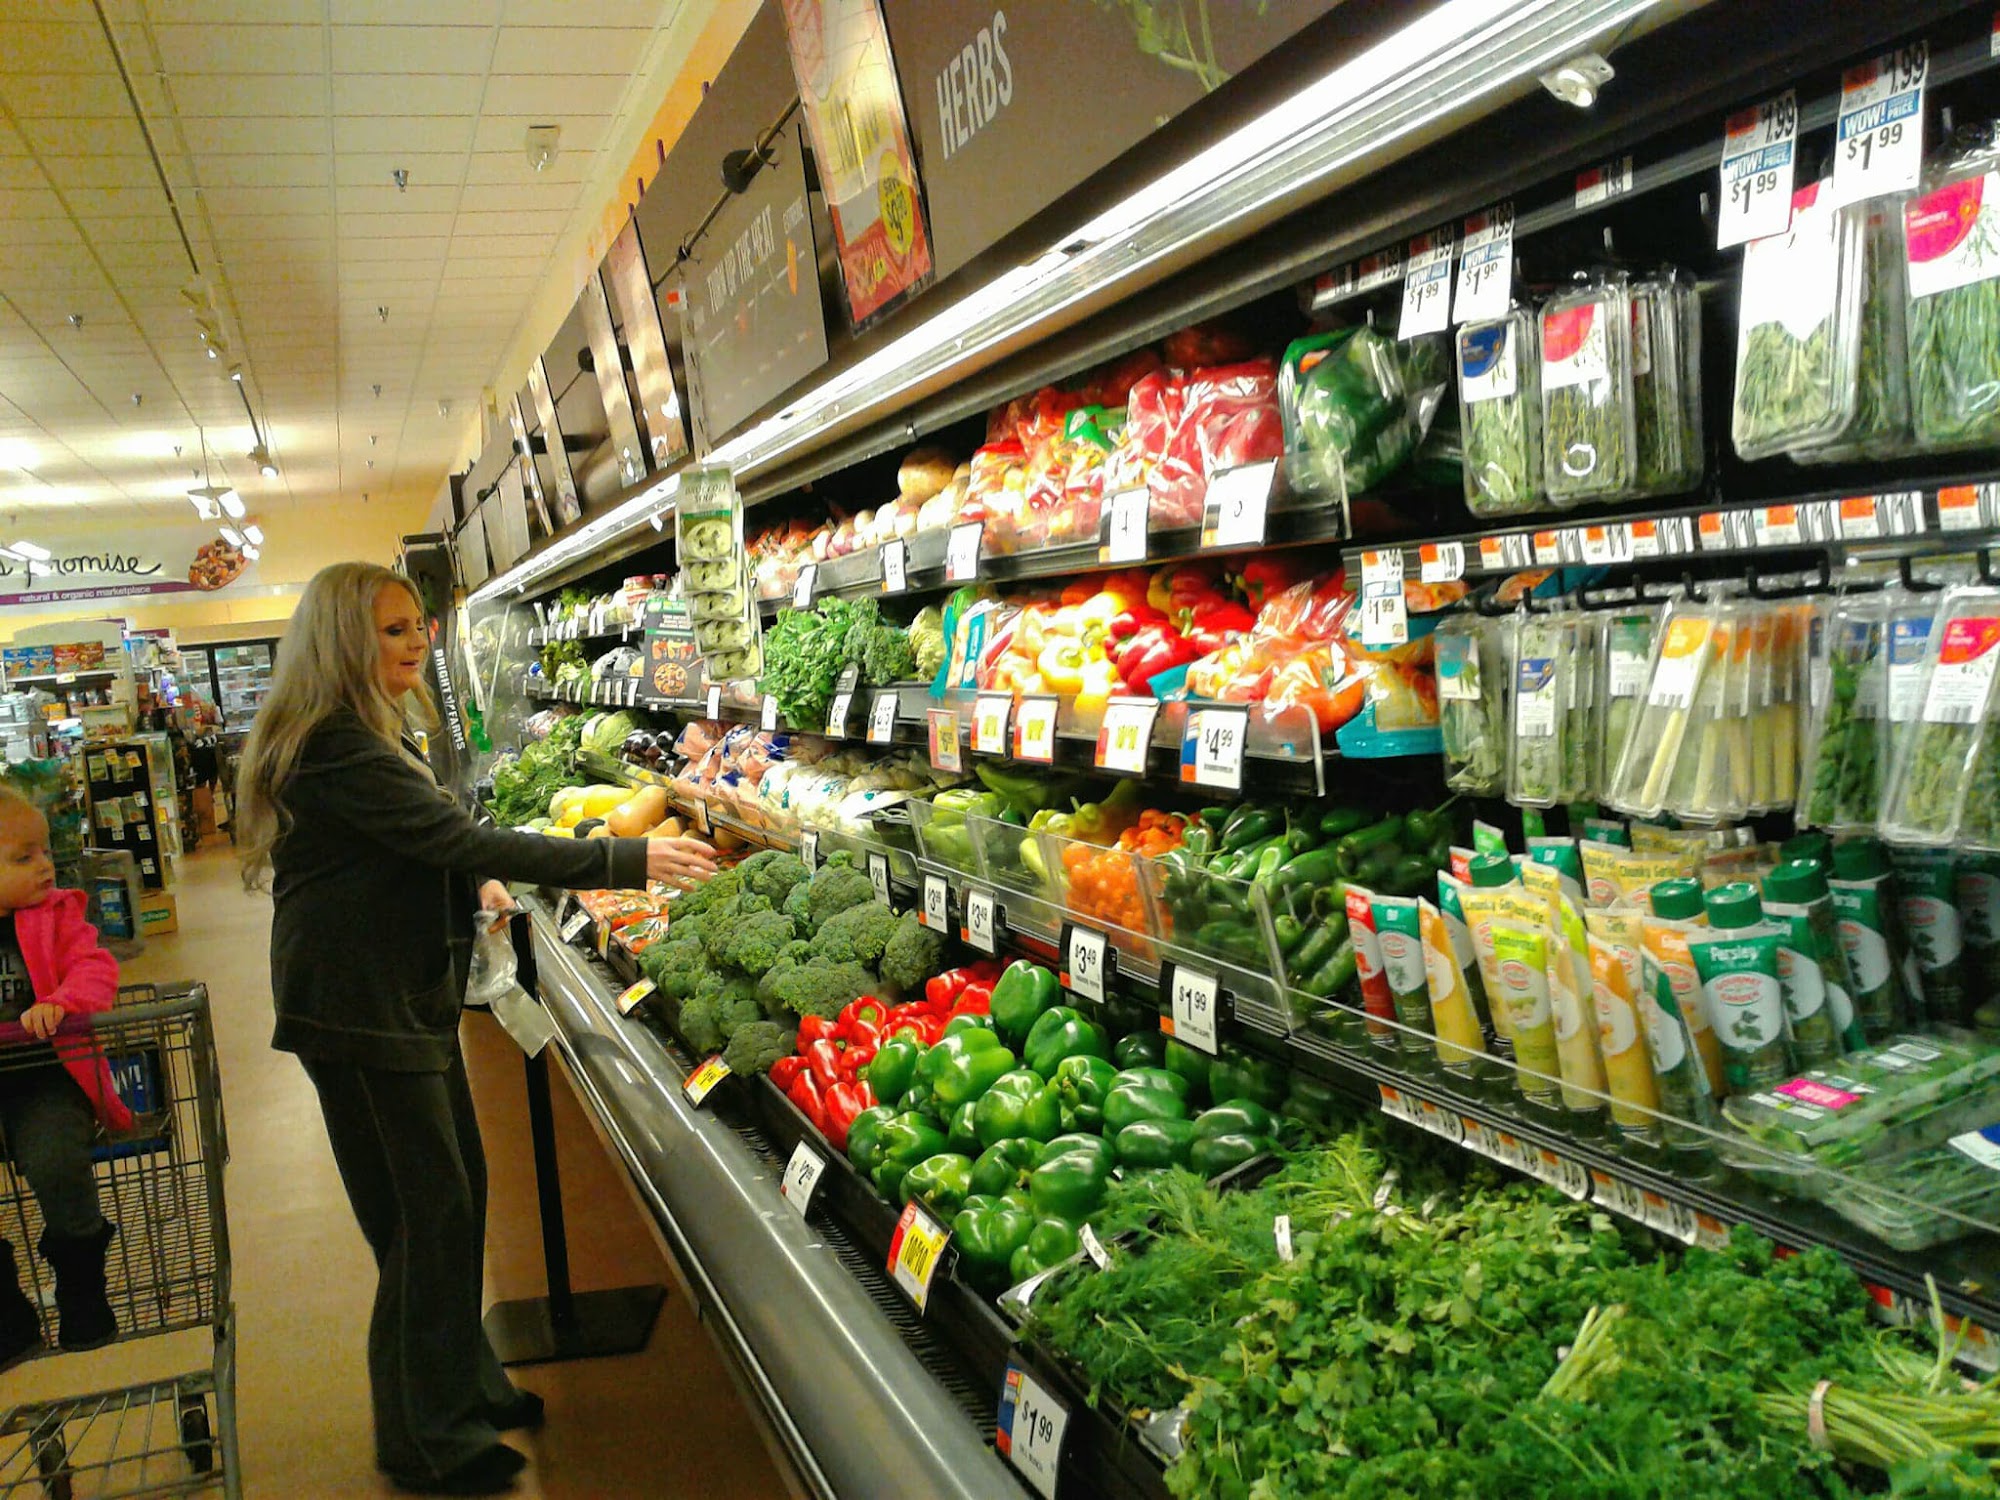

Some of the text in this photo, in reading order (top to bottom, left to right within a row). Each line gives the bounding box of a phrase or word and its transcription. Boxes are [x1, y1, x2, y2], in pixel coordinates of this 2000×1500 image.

[936, 10, 1012, 160] HERBS
[1845, 103, 1914, 137] WOW! PRICE
[736, 229, 754, 284] THE
[751, 204, 775, 264] HEAT
[19, 586, 151, 602] natural & organic marketplace
[434, 648, 466, 751] BRIGHT FARMS
[1710, 945, 1759, 961] Parsley
